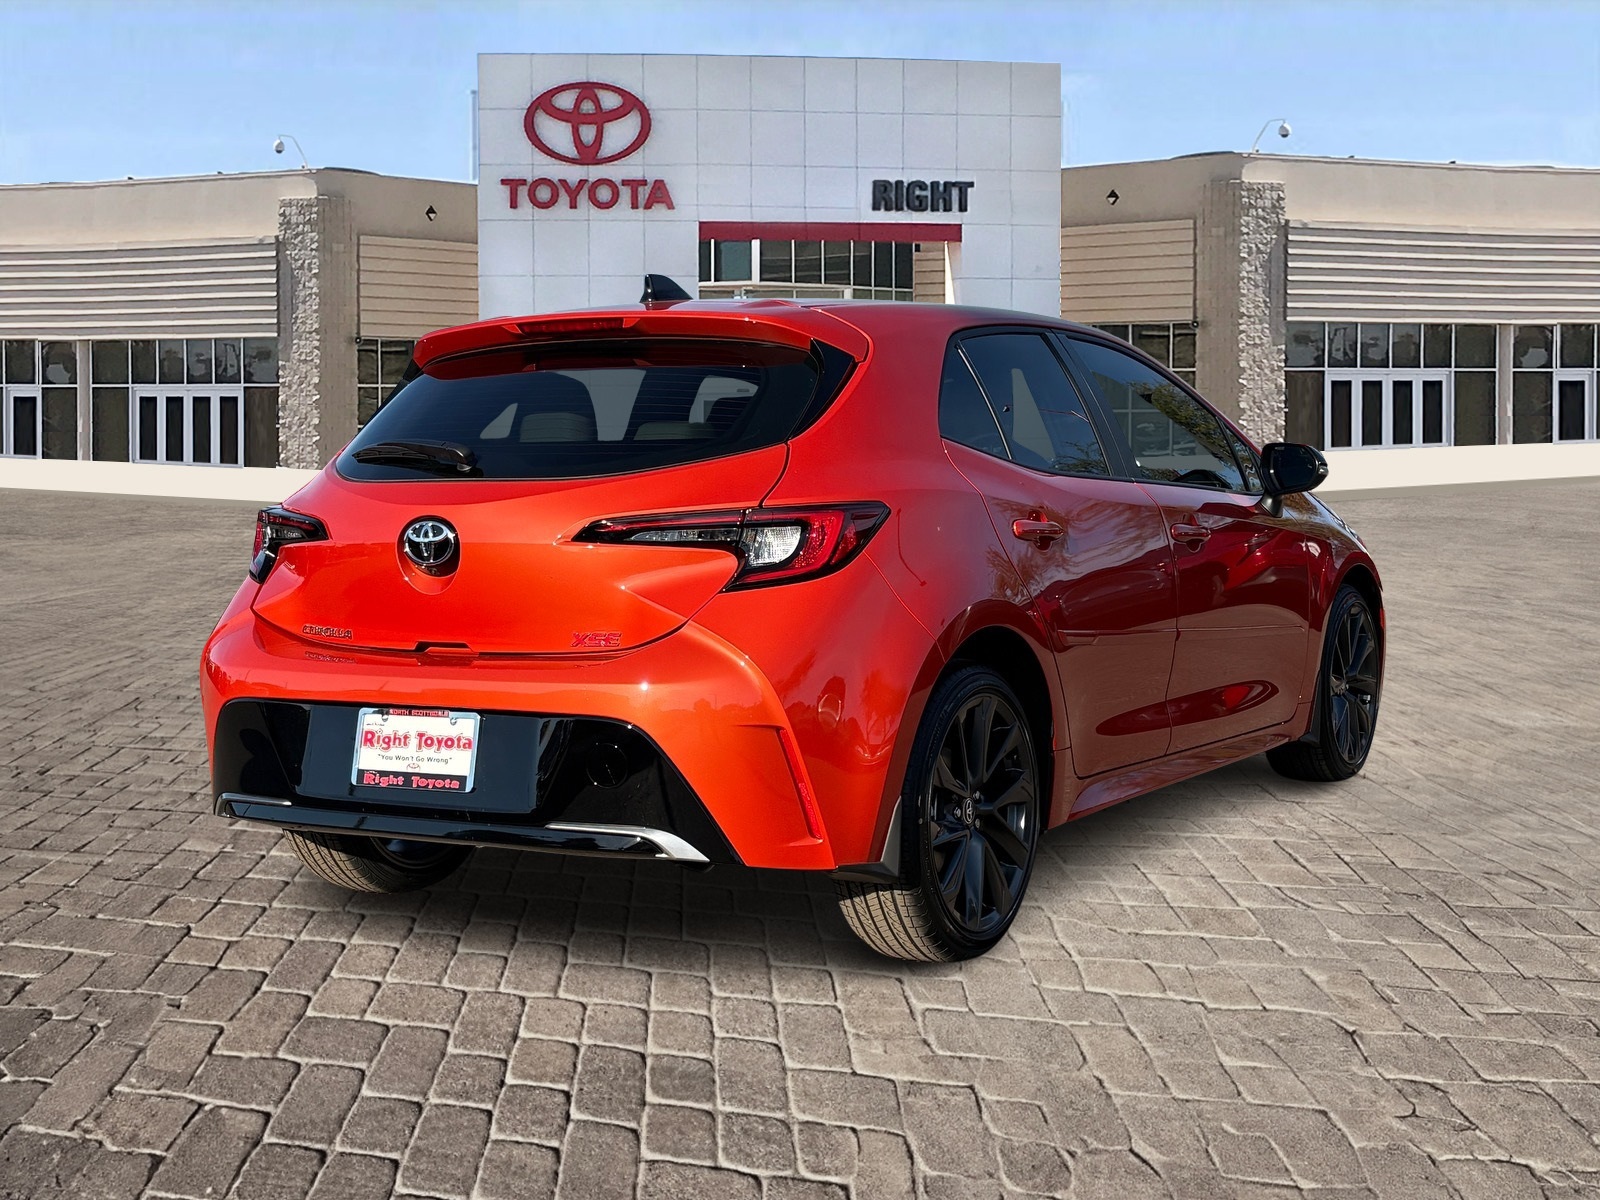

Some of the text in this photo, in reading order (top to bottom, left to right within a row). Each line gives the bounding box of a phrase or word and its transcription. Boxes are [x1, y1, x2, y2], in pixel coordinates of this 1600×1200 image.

[500, 178, 675, 210] TOYOTA
[872, 180, 975, 212] RIGHT
[362, 729, 473, 753] Right Toyota
[395, 755, 414, 763] Won't
[363, 773, 460, 789] Right Toyota
